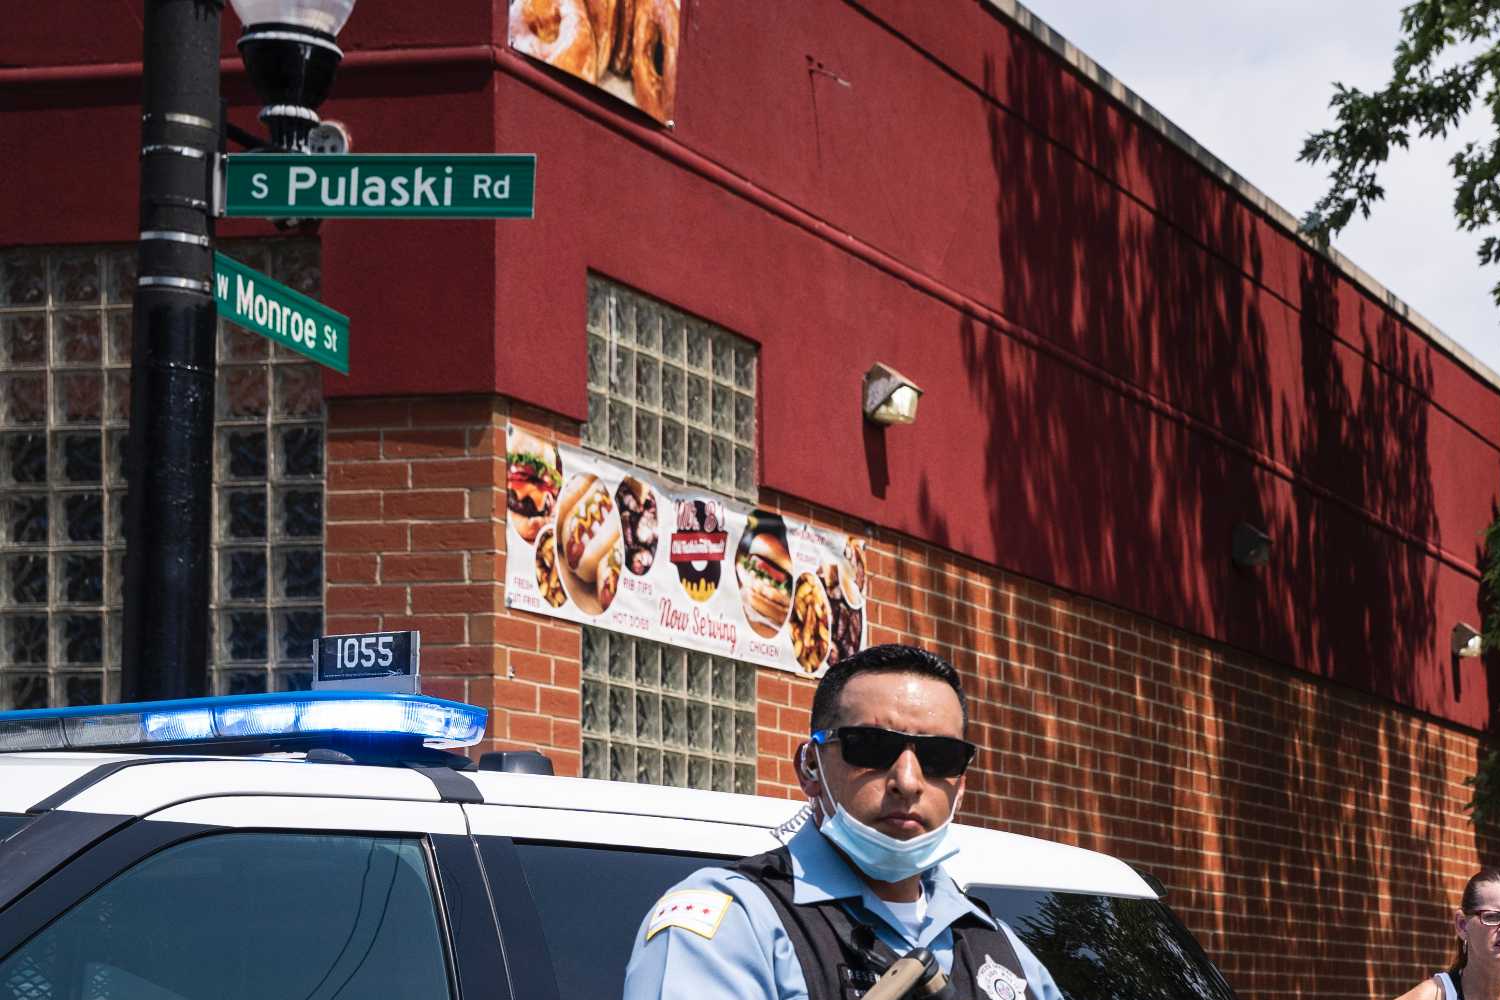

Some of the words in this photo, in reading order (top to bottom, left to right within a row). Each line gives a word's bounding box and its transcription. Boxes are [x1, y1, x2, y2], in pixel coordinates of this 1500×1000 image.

[251, 173, 269, 199] S
[287, 166, 454, 208] Pulaski
[473, 173, 511, 199] Rd
[216, 274, 230, 300] W
[236, 273, 317, 349] Monroe
[324, 325, 338, 352] St
[659, 597, 689, 632] Now
[692, 605, 737, 651] Serving
[336, 635, 394, 669] 1055
